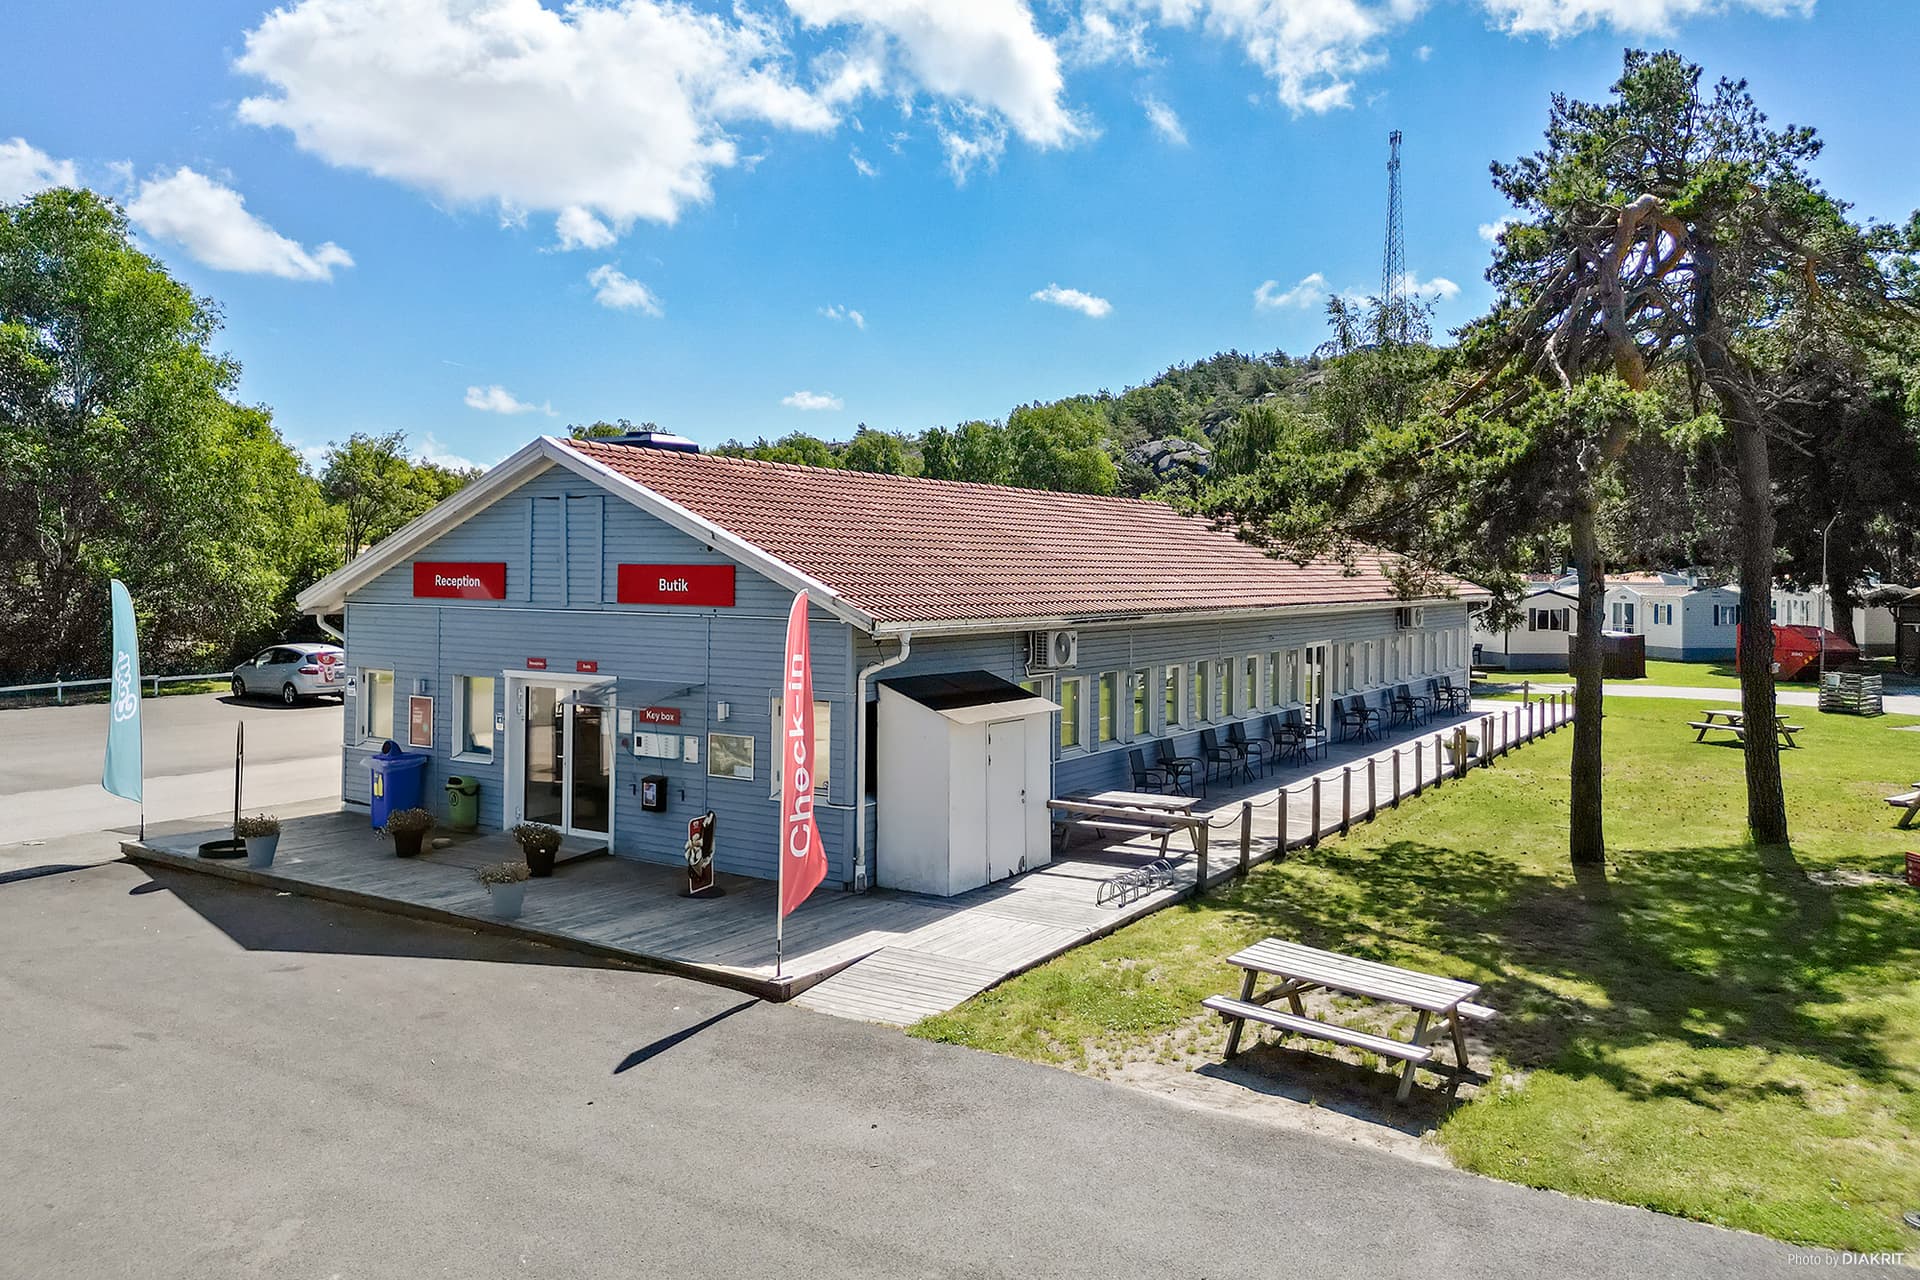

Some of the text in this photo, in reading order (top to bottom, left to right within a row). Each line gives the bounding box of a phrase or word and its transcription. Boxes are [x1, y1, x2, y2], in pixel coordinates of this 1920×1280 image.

[435, 574, 480, 590] Reception
[658, 578, 688, 592] Butik
[646, 710, 674, 722] Key box
[789, 653, 811, 857] Check-in
